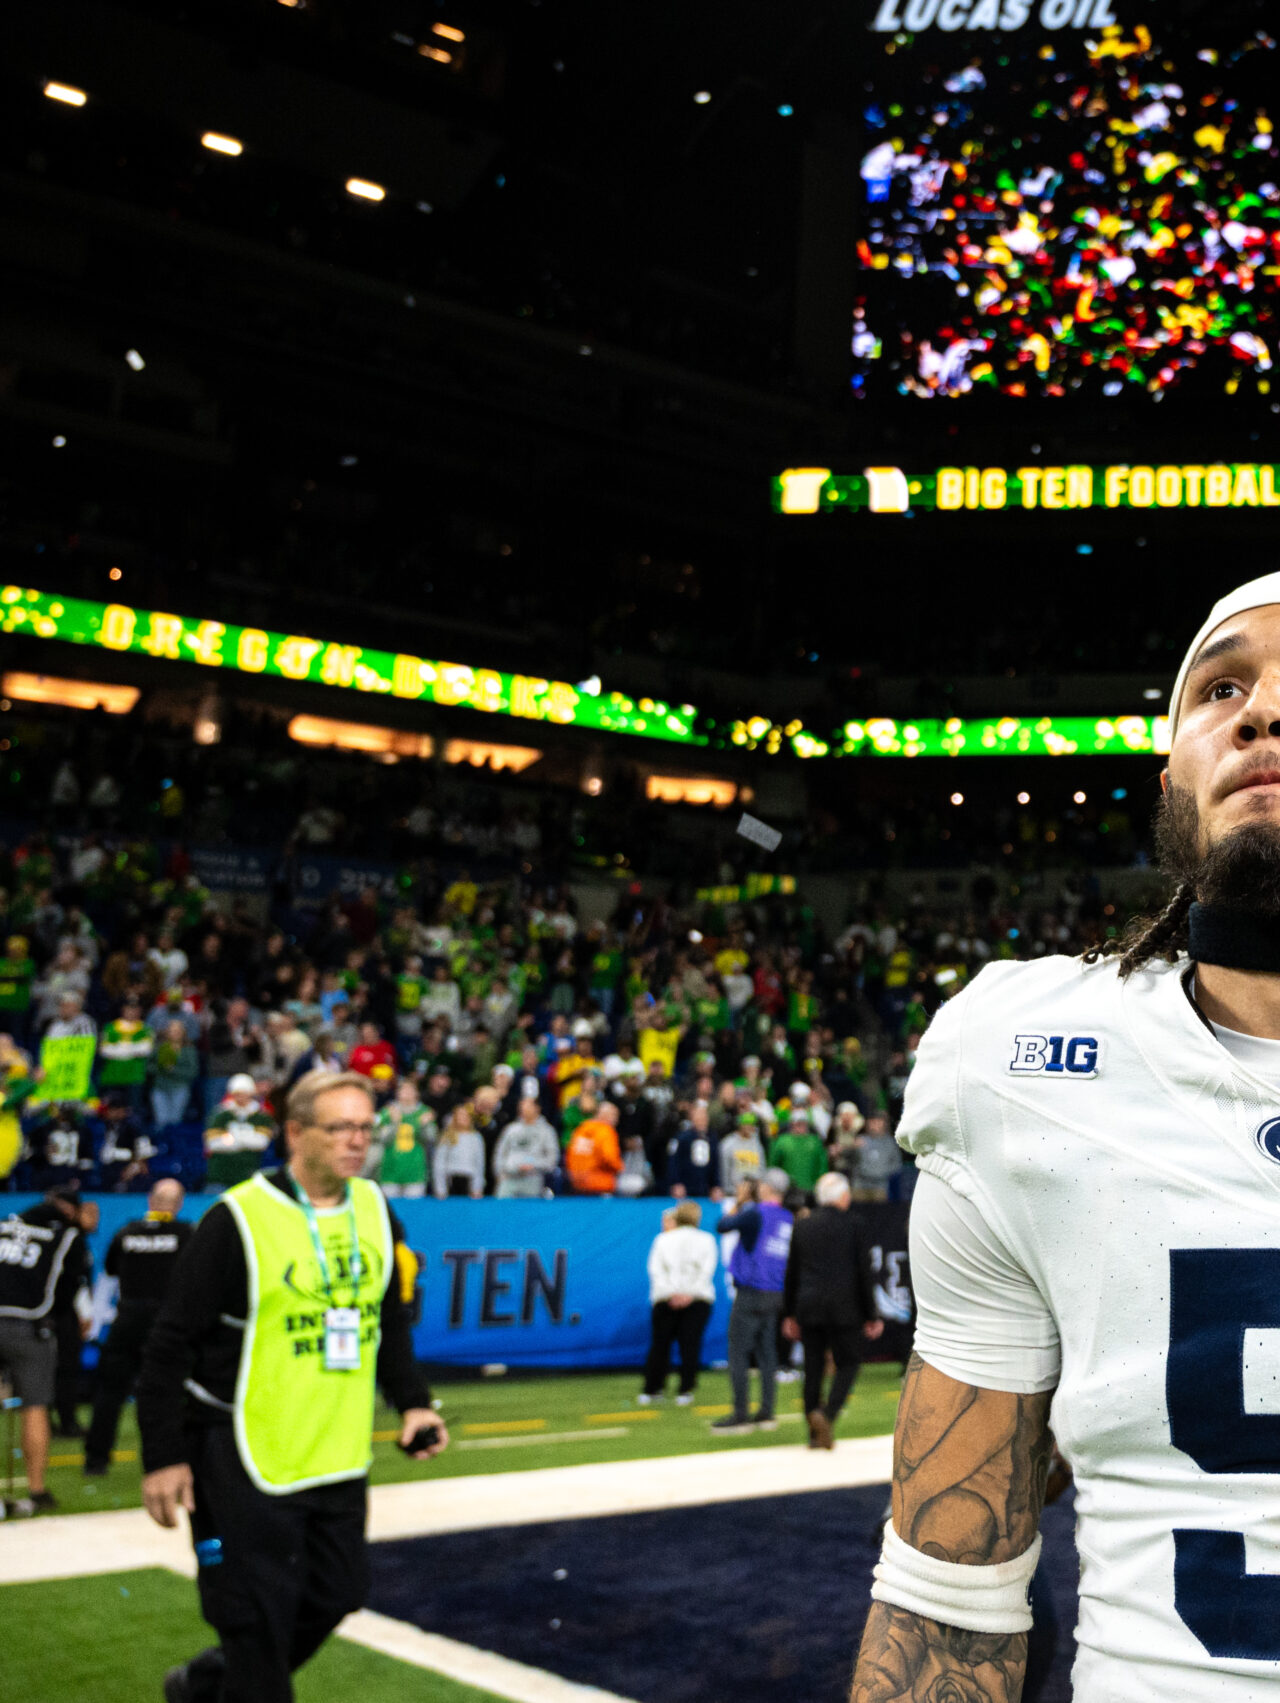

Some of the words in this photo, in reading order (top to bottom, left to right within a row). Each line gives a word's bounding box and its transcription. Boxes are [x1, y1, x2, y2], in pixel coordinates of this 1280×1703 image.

[873, 0, 1031, 31] LUCAS
[1039, 0, 1117, 30] OIL
[936, 467, 1007, 510] BIG
[1017, 465, 1093, 509] TEN
[101, 603, 363, 688] OREGON
[122, 1234, 179, 1252] POLICE
[442, 1249, 582, 1329] TEN.
